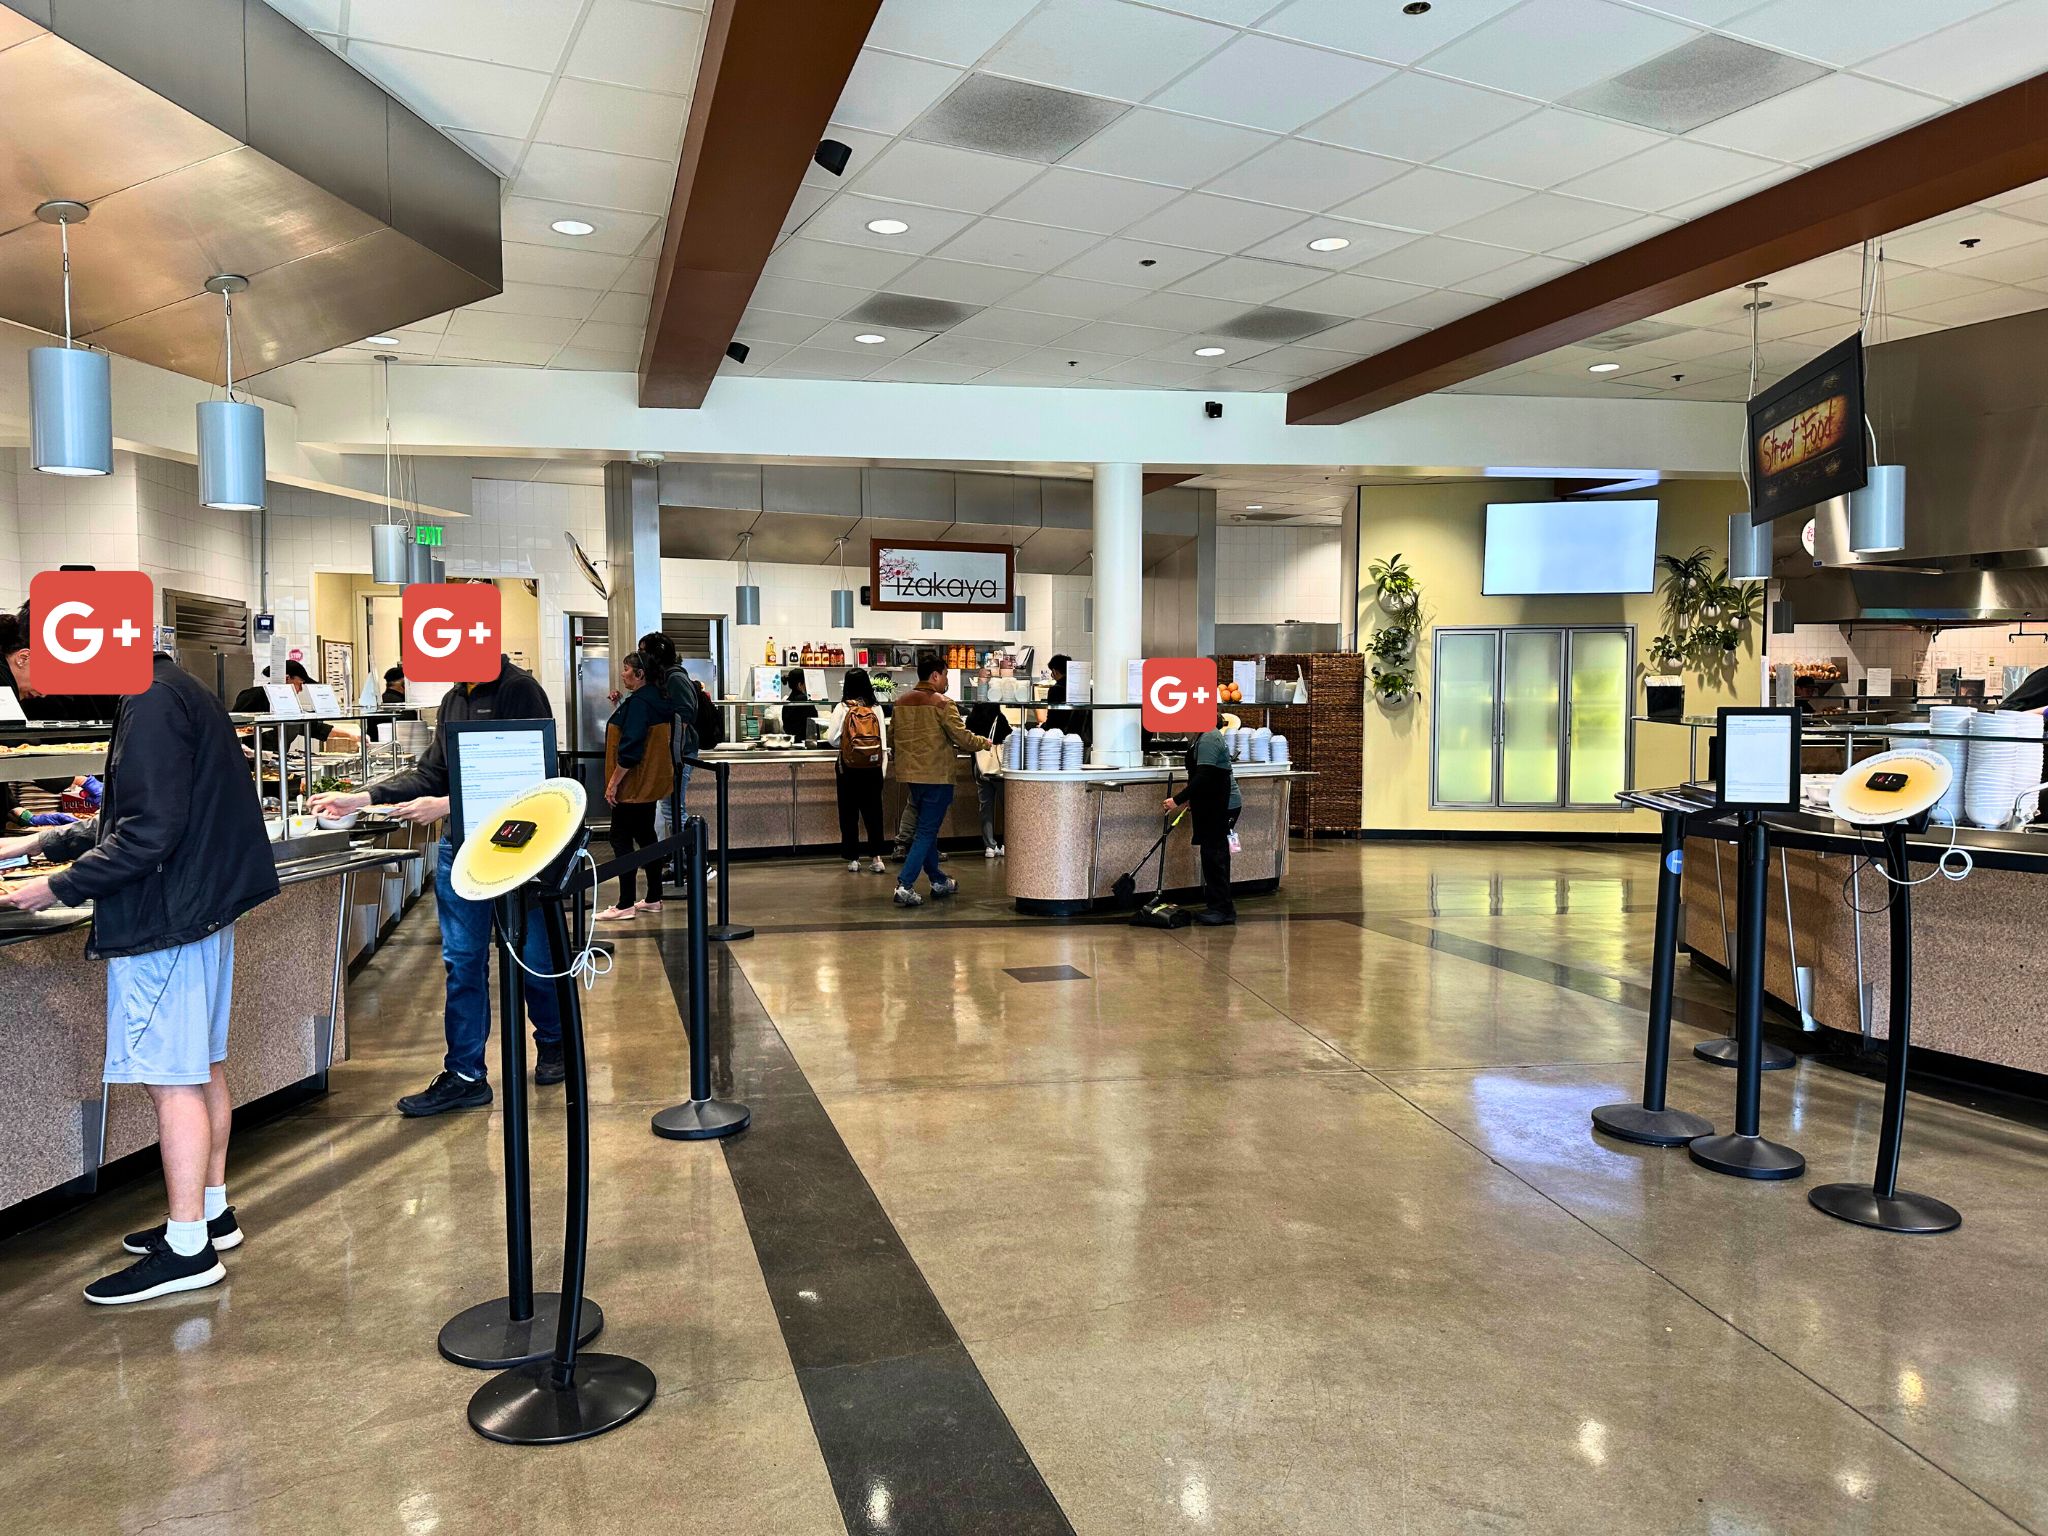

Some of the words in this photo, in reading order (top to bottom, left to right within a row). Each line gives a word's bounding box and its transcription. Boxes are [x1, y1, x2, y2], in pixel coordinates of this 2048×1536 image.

[1762, 418, 1799, 472] Street
[1801, 399, 1834, 460] Food
[416, 525, 443, 546] EXIT
[896, 571, 996, 604] izakaya
